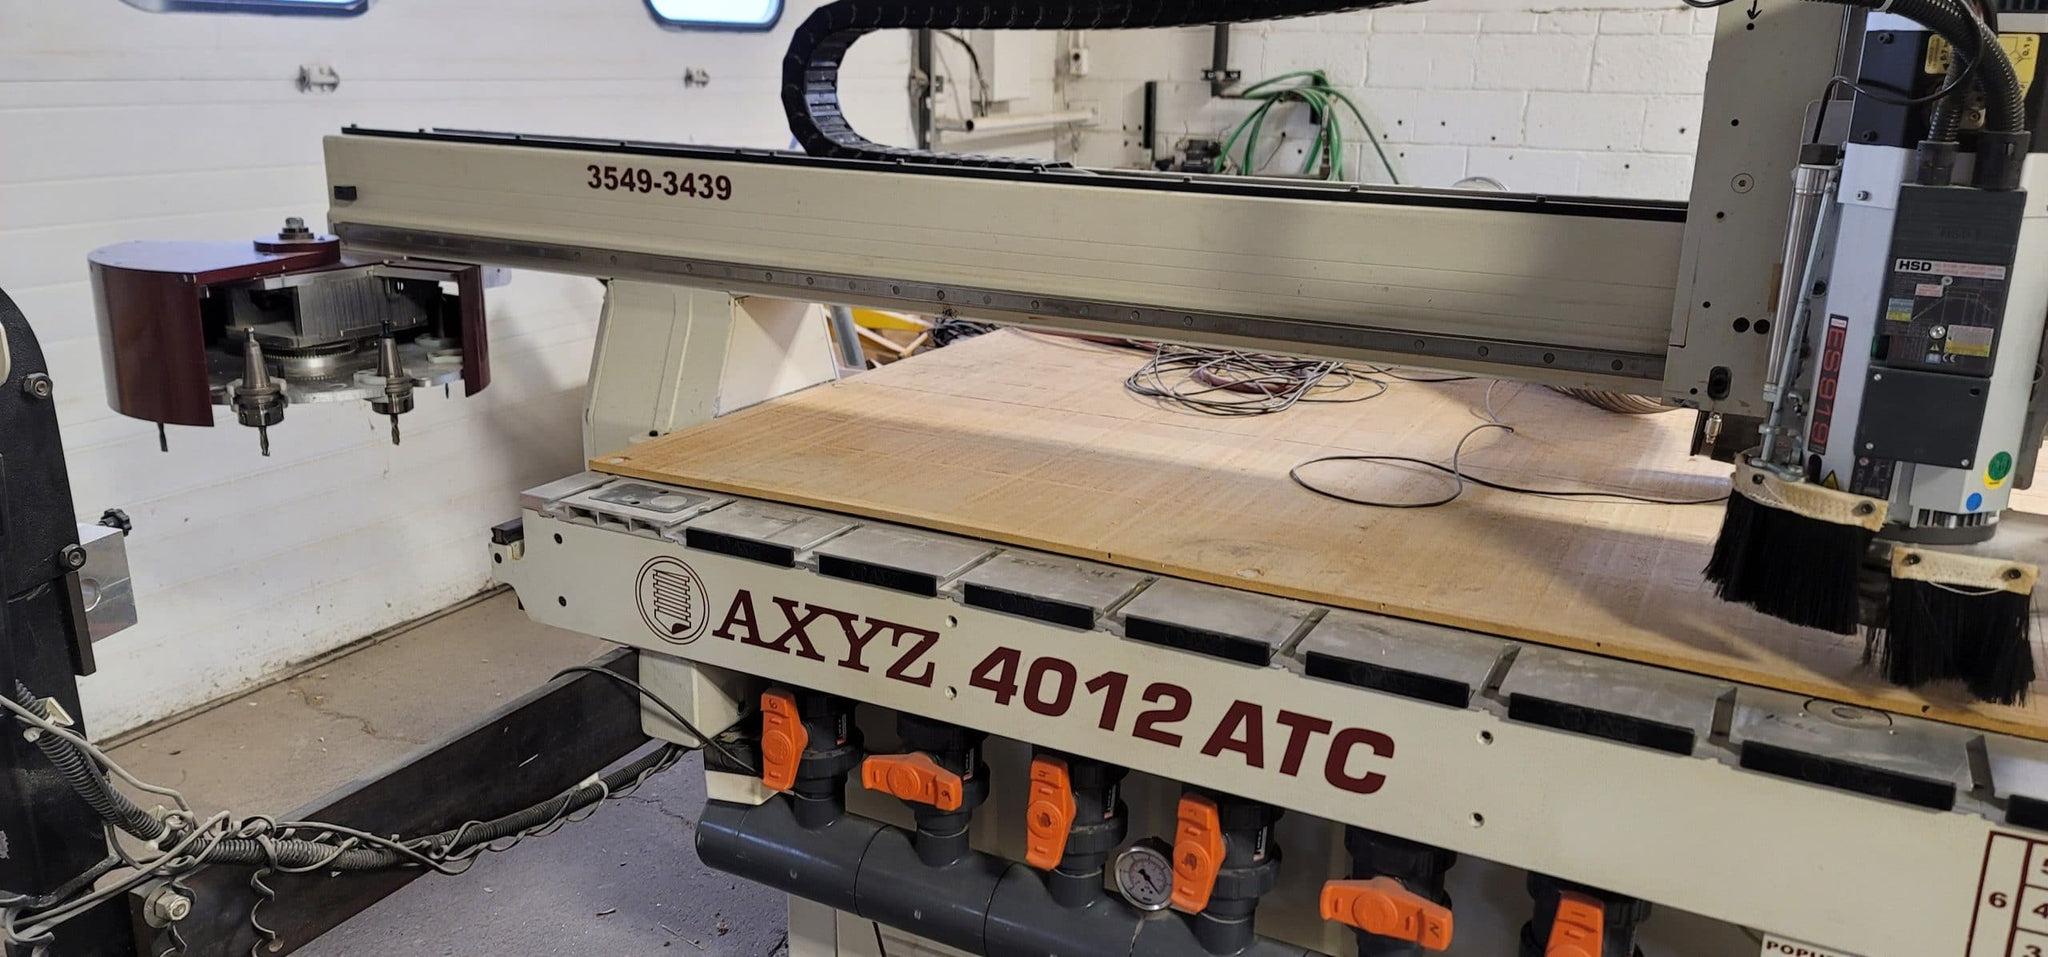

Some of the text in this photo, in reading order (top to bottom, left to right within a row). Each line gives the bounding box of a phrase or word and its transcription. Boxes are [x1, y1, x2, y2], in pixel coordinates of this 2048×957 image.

[587, 165, 732, 201] 3549-3439
[1899, 260, 1932, 272] HSD
[1812, 327, 1846, 445] ES919
[712, 589, 1396, 794] AXYZ 4012 ATC
[1988, 892, 2007, 909] 6
[2033, 903, 2048, 919] 4
